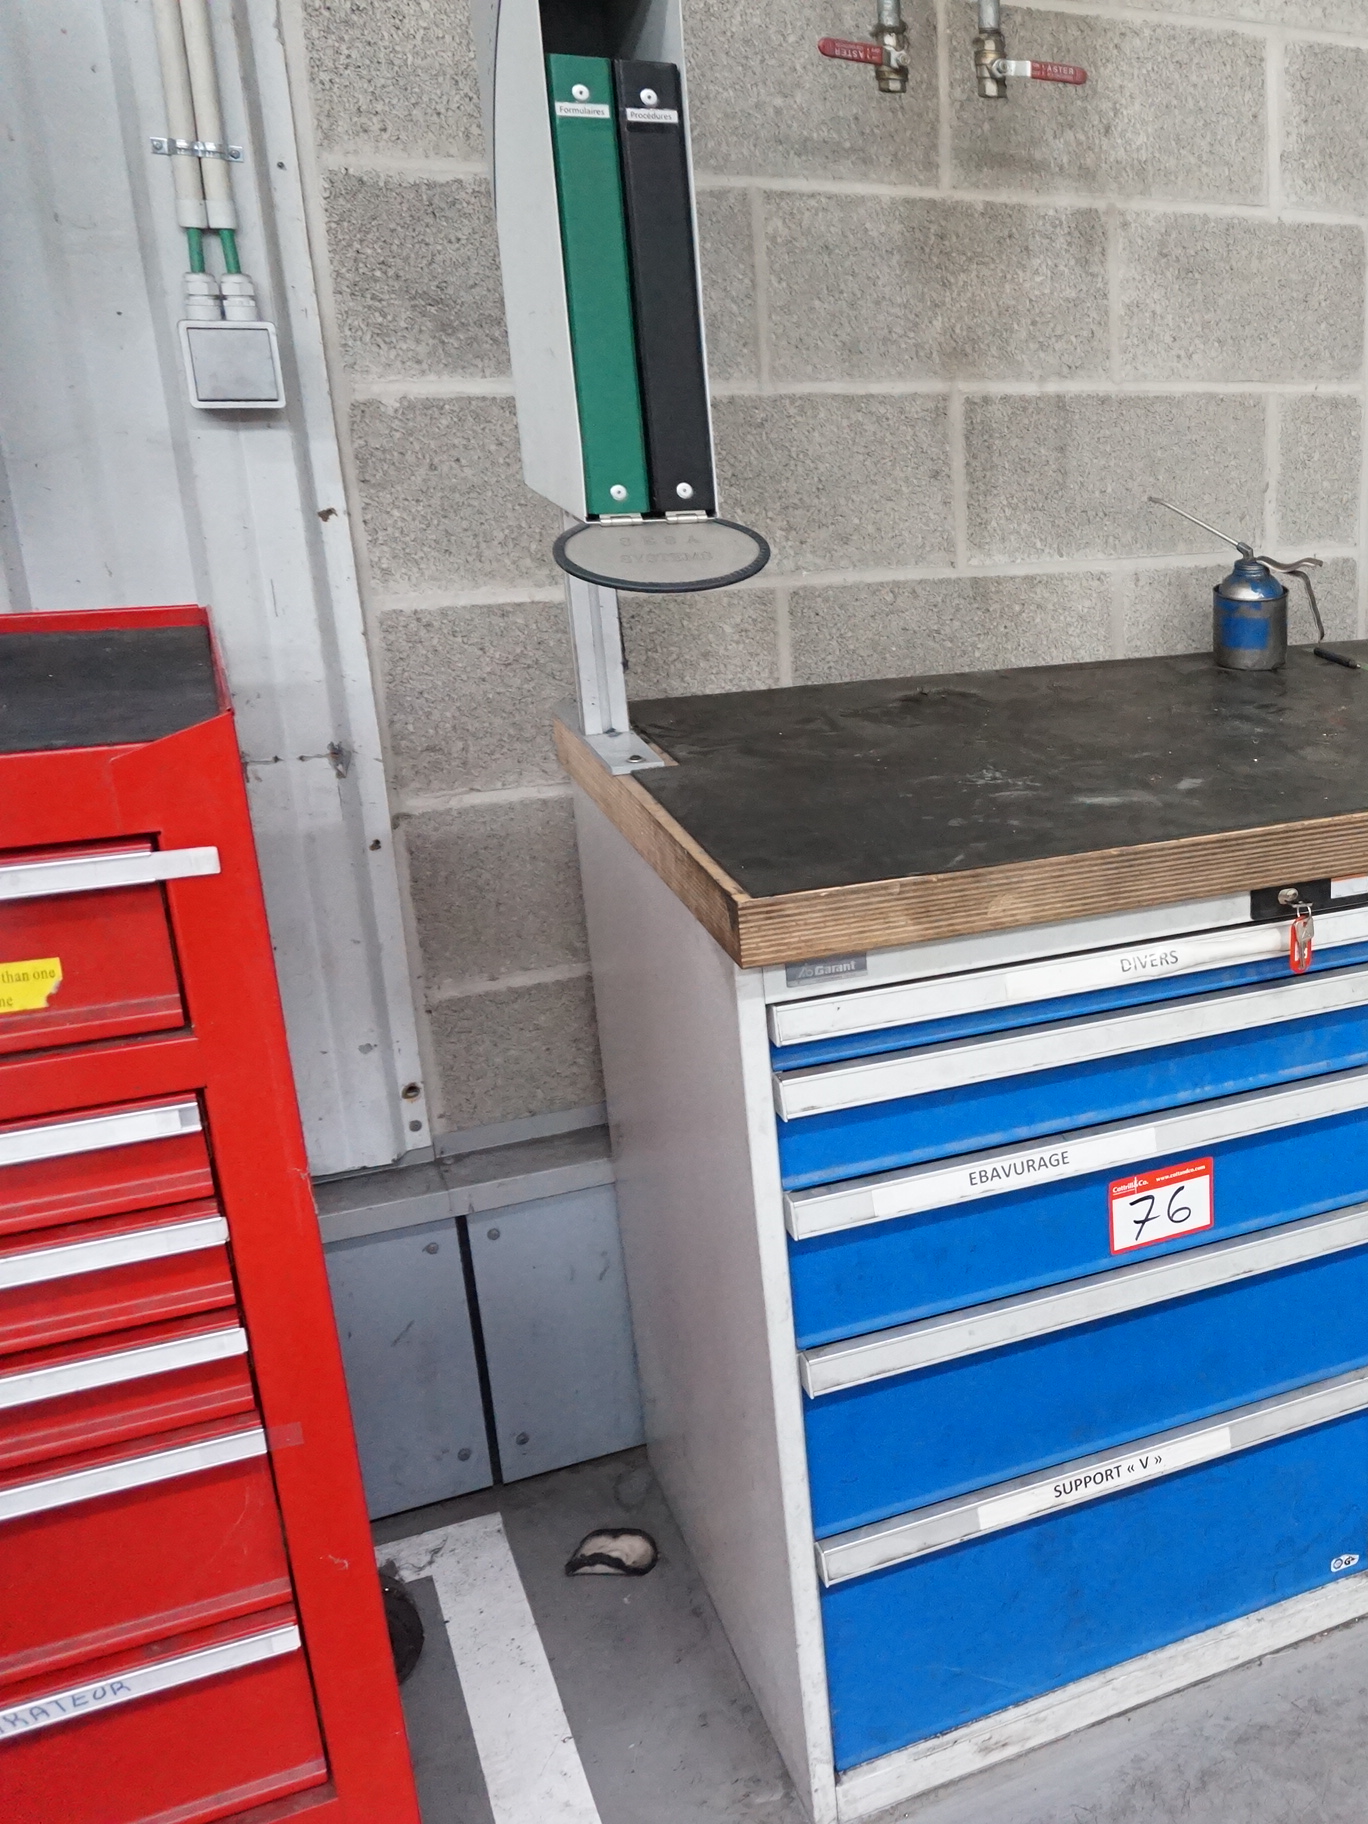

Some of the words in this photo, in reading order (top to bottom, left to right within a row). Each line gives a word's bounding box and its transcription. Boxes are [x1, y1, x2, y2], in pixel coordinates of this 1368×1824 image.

[559, 105, 606, 116] Formulaires
[630, 111, 673, 121] Procédures
[814, 960, 857, 976] Garant
[1120, 950, 1179, 973] DIVERS
[1, 970, 30, 984] than
[32, 969, 56, 980] one
[968, 1150, 1070, 1187] EBAVURAGE
[1128, 1185, 1192, 1241] 76
[1053, 1464, 1122, 1498] SUPPORT
[1138, 1456, 1150, 1470] V
